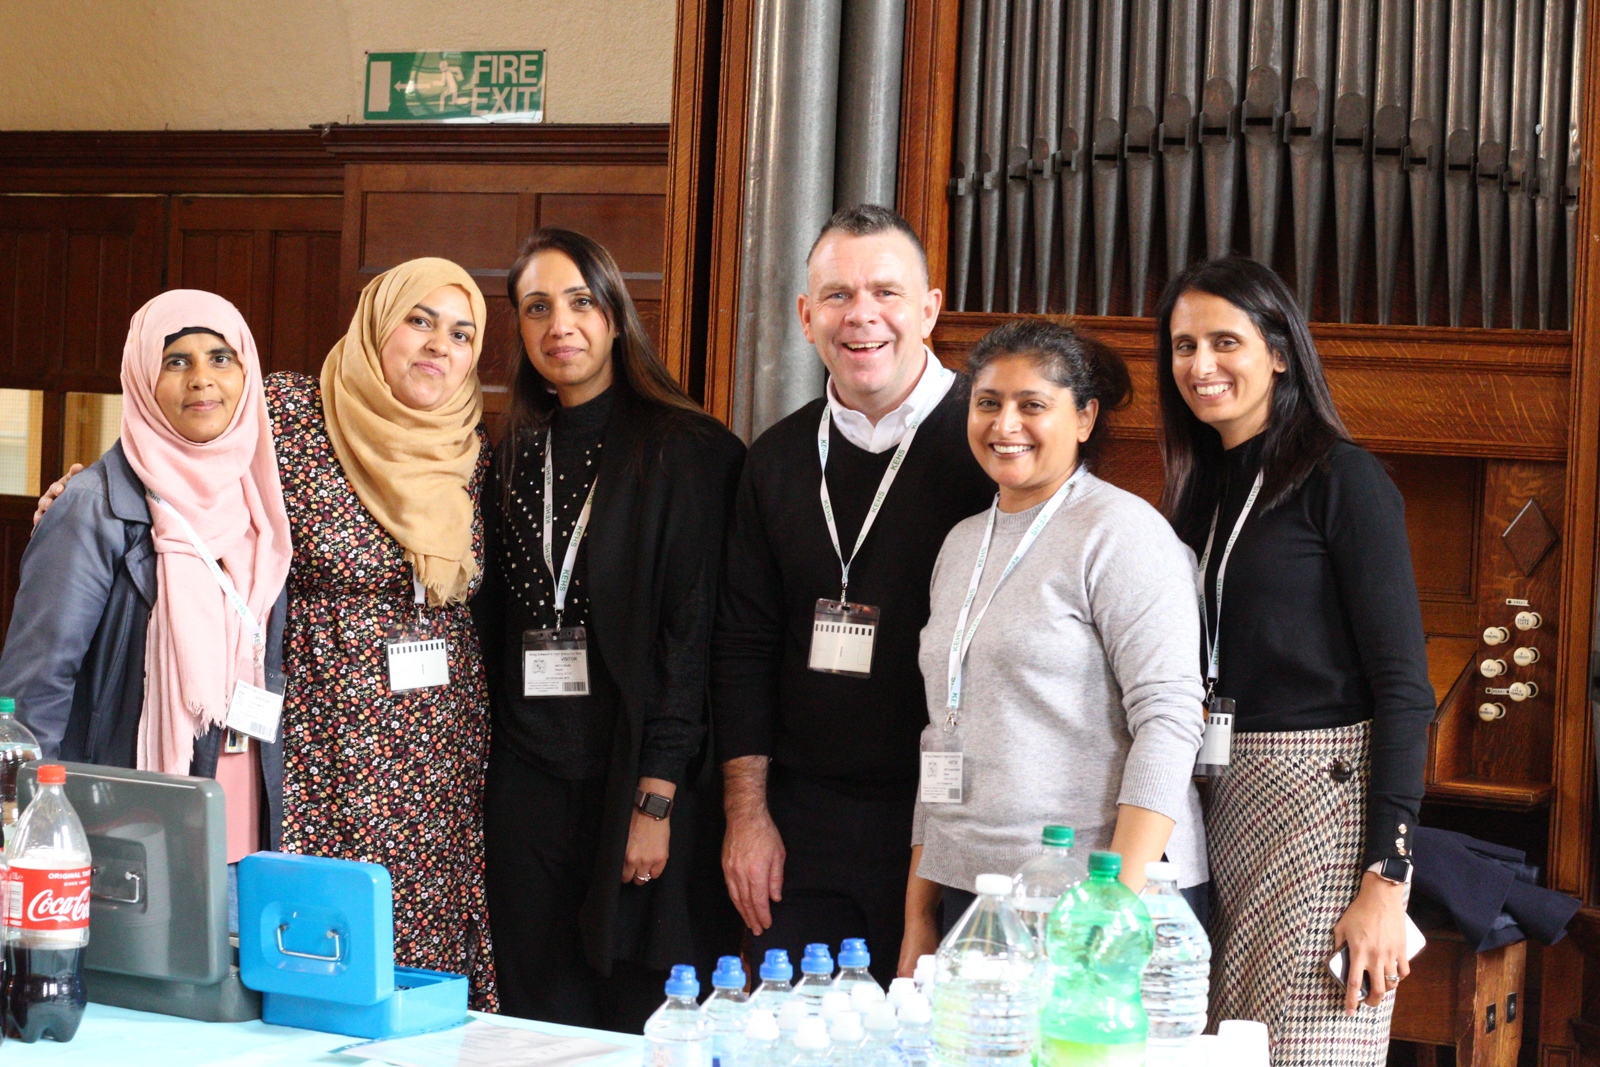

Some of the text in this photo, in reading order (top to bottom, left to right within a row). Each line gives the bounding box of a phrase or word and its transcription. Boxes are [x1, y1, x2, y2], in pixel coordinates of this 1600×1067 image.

[474, 54, 539, 84] FIRE
[470, 86, 538, 116] EXIT
[889, 449, 906, 471] KEHS
[870, 490, 885, 514] KEHS
[1245, 485, 1260, 508] KEHS
[823, 499, 833, 523] KEHS
[570, 525, 584, 548] KEHS
[1030, 513, 1049, 537] KEHS
[1225, 530, 1239, 554] KEHS
[976, 546, 987, 569] KEHS
[559, 568, 570, 592] KEHS
[232, 594, 248, 616] KEHS
[963, 588, 976, 609] KEHS
[253, 632, 261, 645] KE
[952, 629, 963, 652] KEHS
[965, 617, 980, 641] KEHS
[950, 692, 959, 708] KE
[48, 872, 82, 880] ORIGINAL
